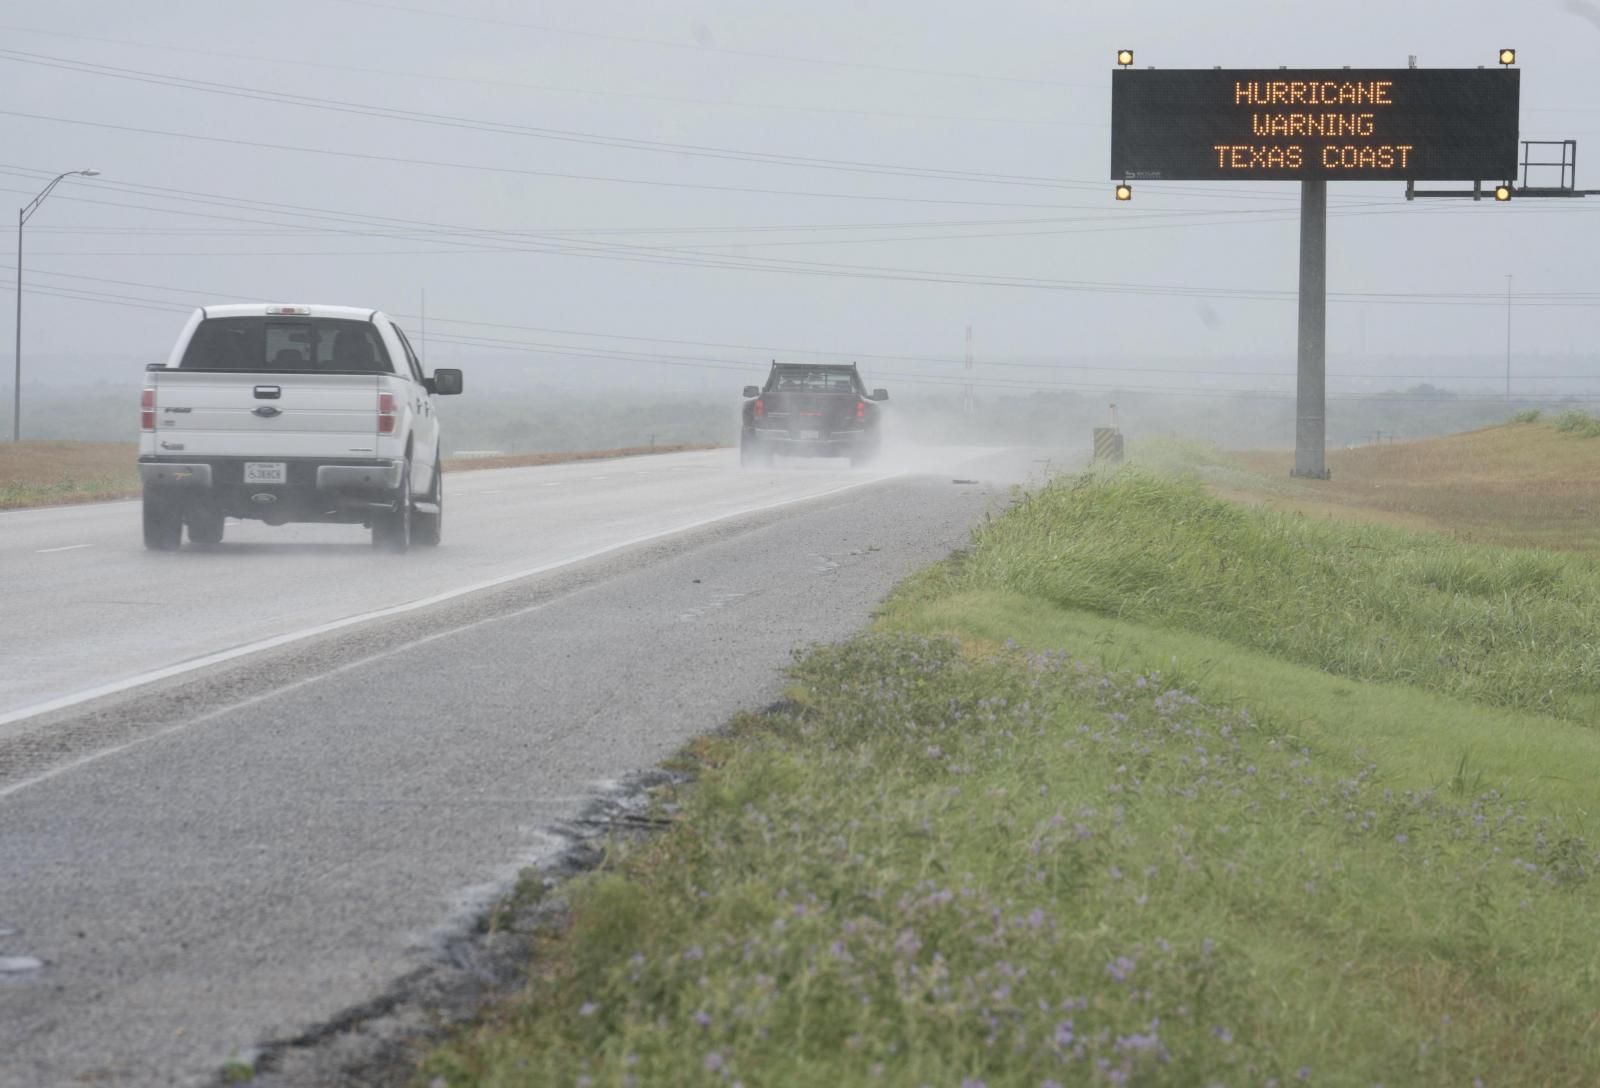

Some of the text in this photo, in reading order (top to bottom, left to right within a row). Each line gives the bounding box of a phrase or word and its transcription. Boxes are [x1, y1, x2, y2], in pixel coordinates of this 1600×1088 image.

[1235, 81, 1393, 105] HURRICANE
[1252, 113, 1375, 137] WARNING
[1214, 144, 1413, 169] TEXAS COAST
